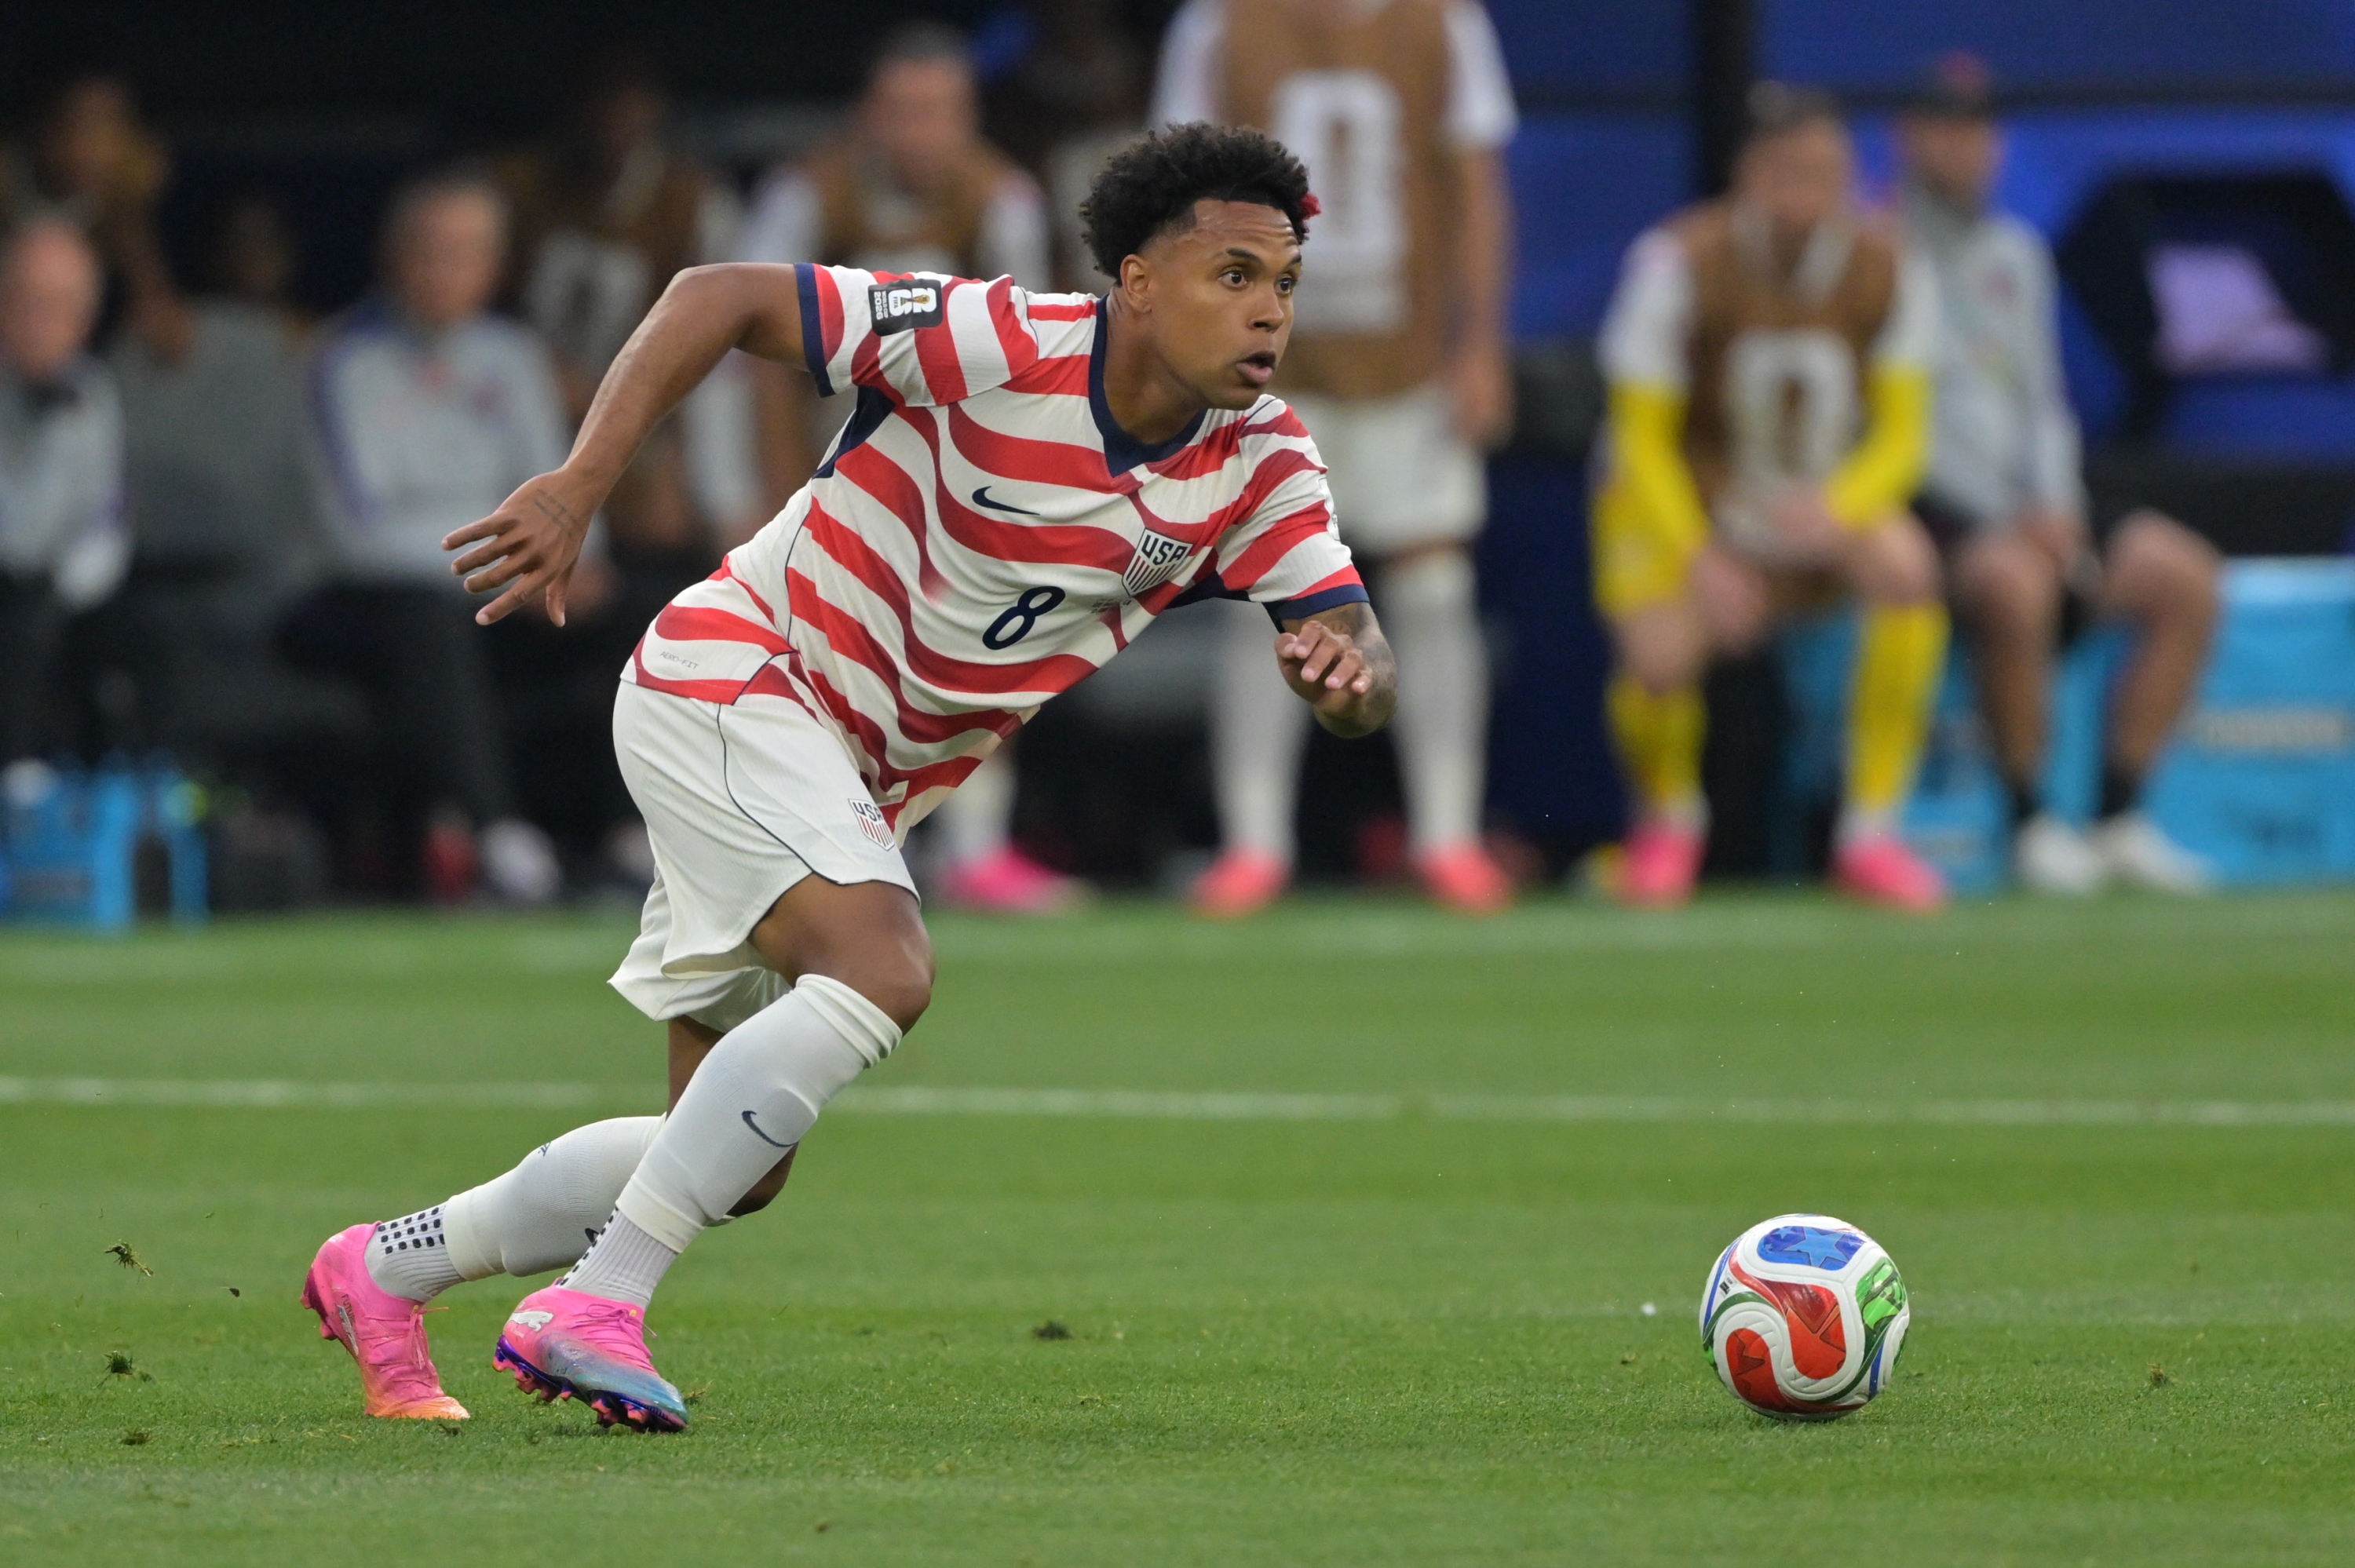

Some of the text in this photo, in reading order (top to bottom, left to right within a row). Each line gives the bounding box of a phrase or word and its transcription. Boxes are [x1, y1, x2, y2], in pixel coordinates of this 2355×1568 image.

[874, 291, 884, 320] 2026
[1141, 534, 1188, 567] USA
[982, 586, 1066, 650] 8
[659, 651, 699, 669] AERO-FIT
